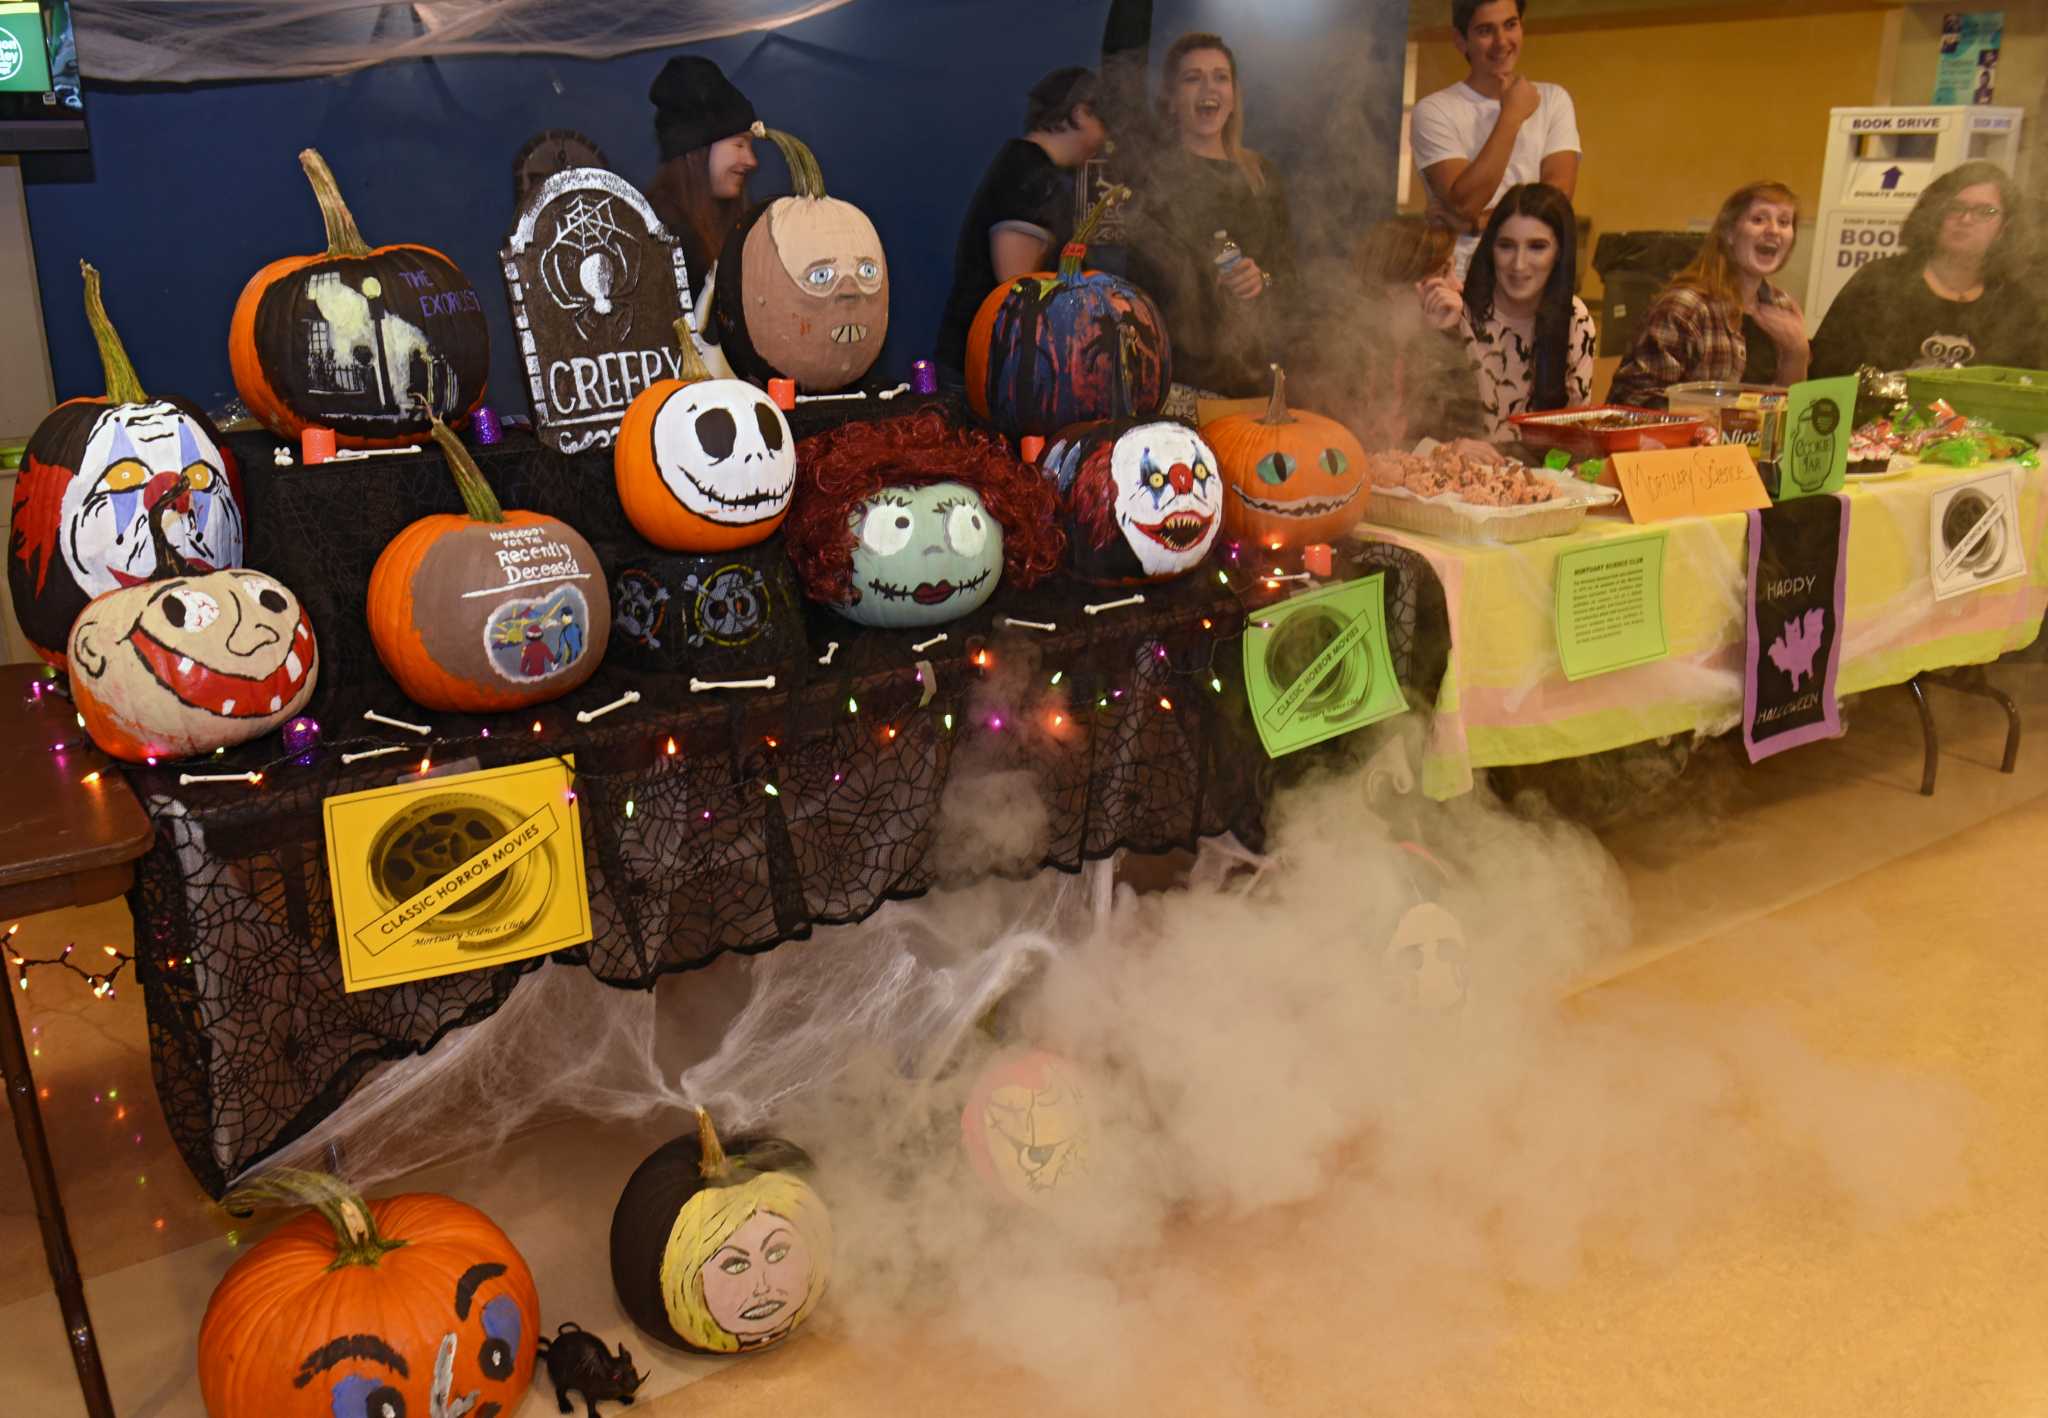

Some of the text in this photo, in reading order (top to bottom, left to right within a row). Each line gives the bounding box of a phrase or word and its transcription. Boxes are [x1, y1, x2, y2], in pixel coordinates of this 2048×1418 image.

[1852, 117, 1940, 129] BOOK DRIVE
[399, 269, 434, 291] THE
[419, 289, 481, 318] EXORCIST
[550, 346, 682, 414] CREEPY
[1722, 429, 1760, 446] Nips
[495, 541, 571, 568] Recently
[503, 559, 580, 584] Deceased
[1767, 575, 1817, 600] HAPPY
[1277, 625, 1360, 716] CLASSIC HORROR MOVIES
[1758, 693, 1819, 723] HALLOWEEN
[381, 823, 540, 935] CLASSIC HORROR MOVIES
[414, 917, 528, 947] Mortuary Science Club
